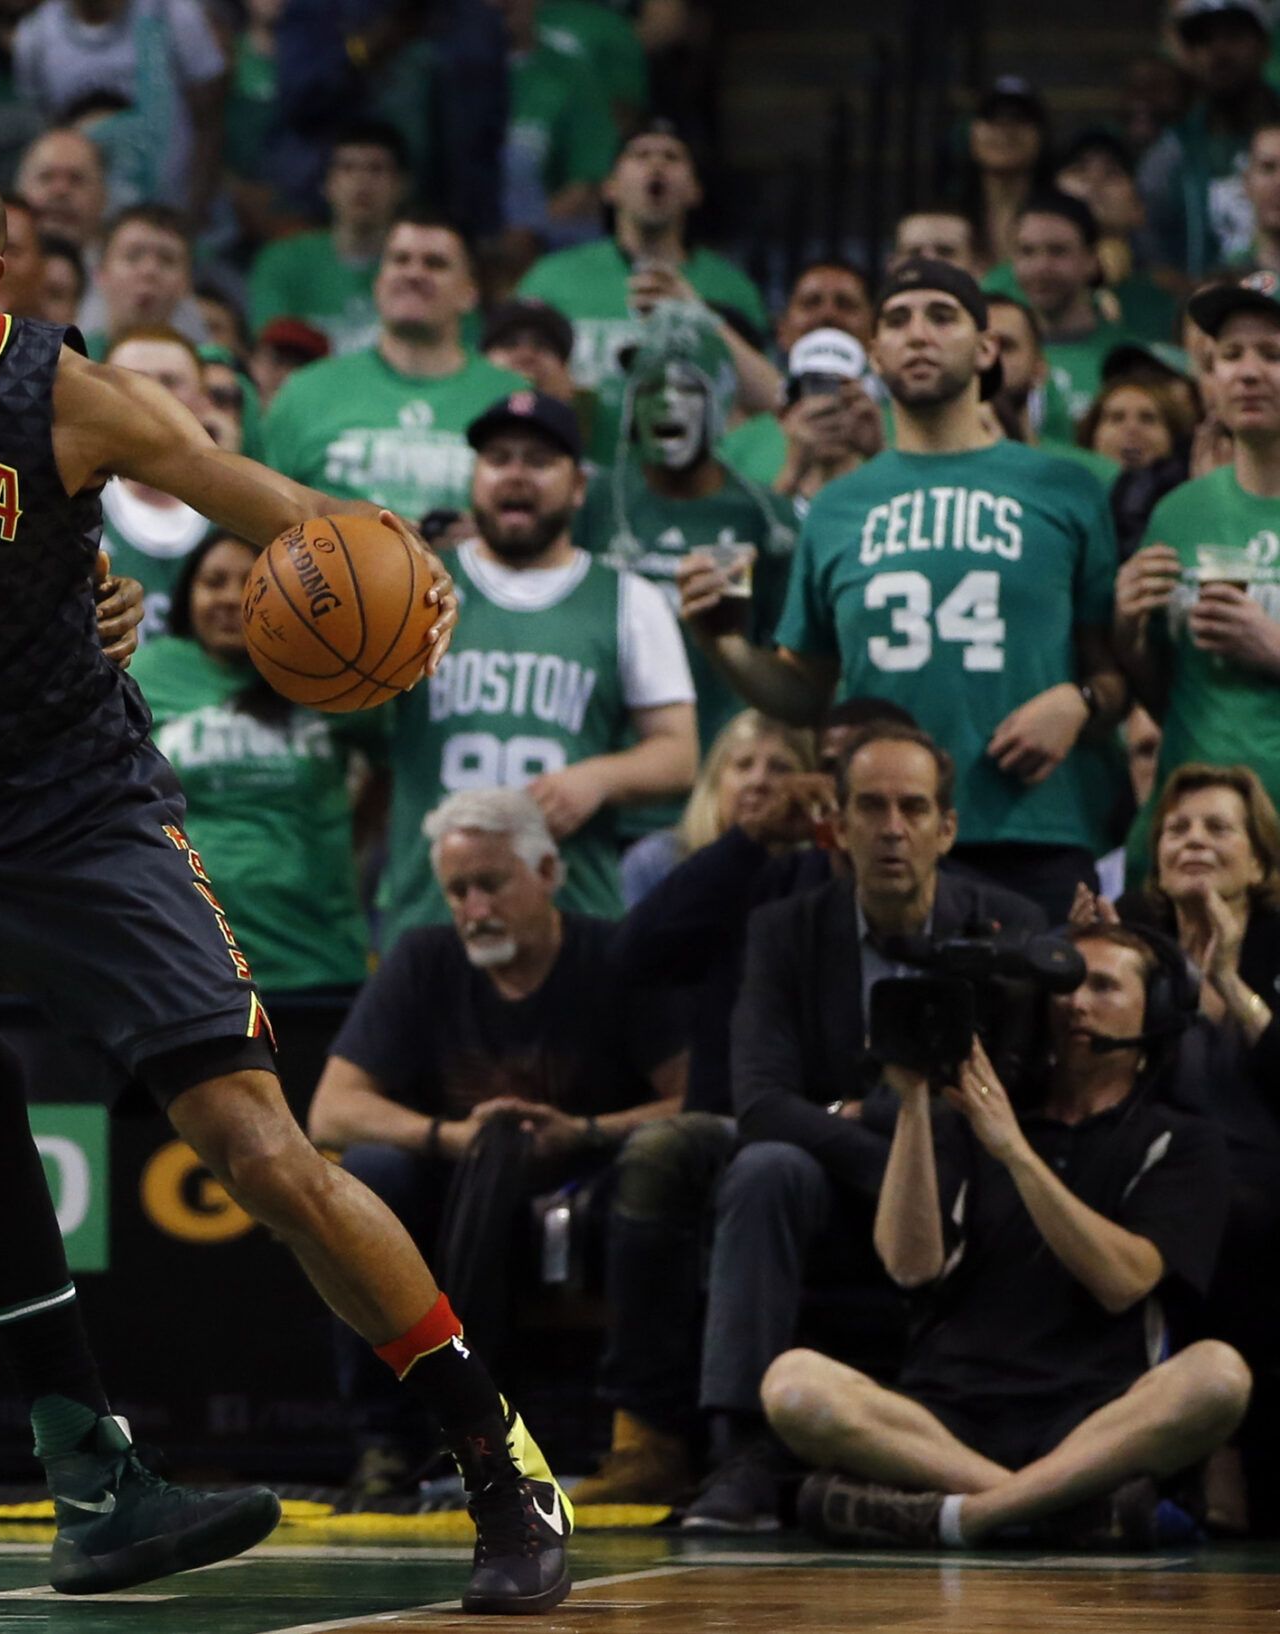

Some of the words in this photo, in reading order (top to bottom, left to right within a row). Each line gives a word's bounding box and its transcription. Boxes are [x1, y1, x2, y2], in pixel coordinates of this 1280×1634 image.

[279, 523, 342, 619] PALDING
[858, 486, 1023, 566] CELTICS
[863, 569, 1007, 672] 34
[428, 648, 597, 735] BOSTON
